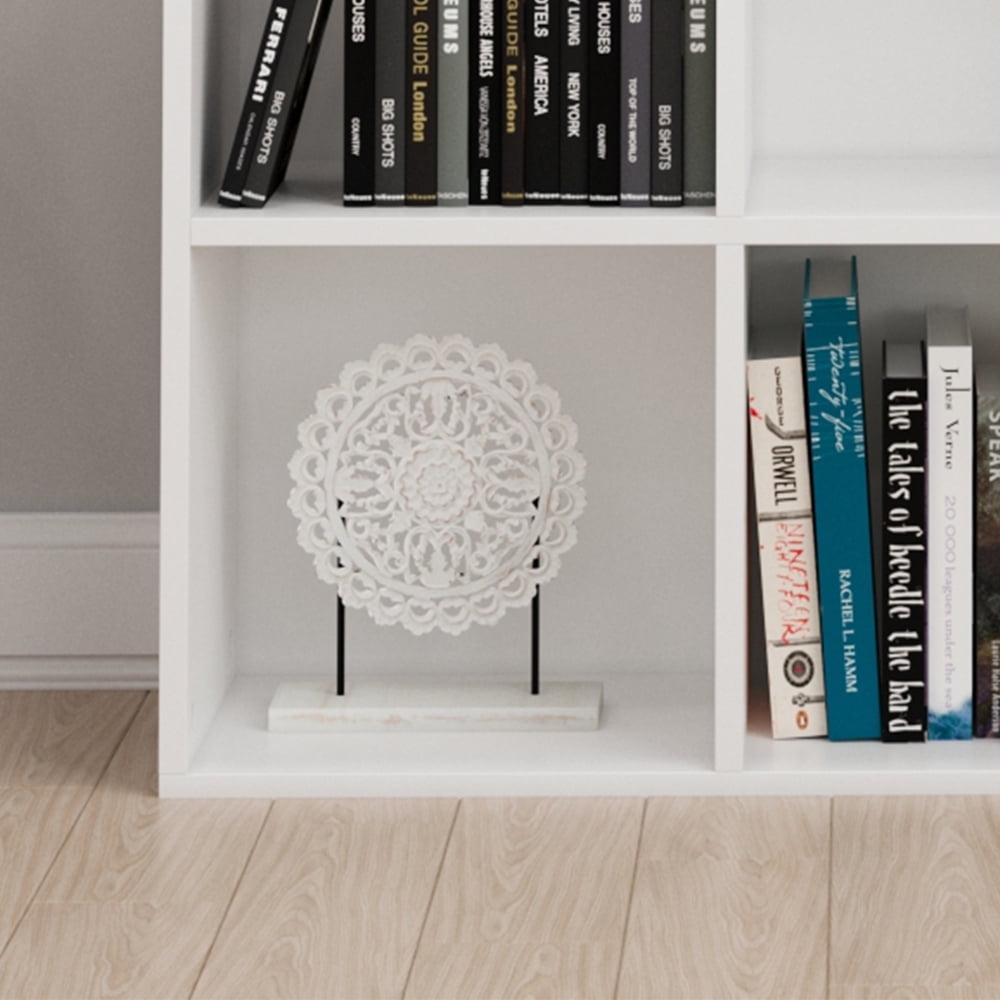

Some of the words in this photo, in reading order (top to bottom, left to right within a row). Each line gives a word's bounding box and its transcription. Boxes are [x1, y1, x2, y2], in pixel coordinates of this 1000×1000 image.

[412, 20, 429, 75] GUIDE
[568, 6, 580, 47] LIVING
[598, 1, 611, 55] HOUSES
[252, 6, 288, 102] FERRARI
[479, 39, 494, 78] ANGELS
[269, 90, 286, 116] BIG
[505, 65, 518, 133] London
[533, 54, 549, 117] AMERICA
[568, 72, 580, 104] NEW
[628, 77, 637, 96] TOP
[628, 96, 637, 110] OF
[381, 98, 395, 121] BIG
[412, 80, 428, 142] London
[568, 105, 580, 138] YORK
[628, 111, 637, 129] THE
[658, 104, 671, 126] BIG
[257, 115, 279, 165] SHOTS
[351, 117, 360, 157] COUNTRY
[381, 122, 396, 168] SHOTS
[628, 129, 637, 163] WORLD
[658, 127, 672, 171] SHOTS
[940, 365, 971, 411] Jules
[887, 389, 922, 432] the
[944, 418, 961, 471] Verne
[771, 445, 798, 507] ORWELL
[887, 438, 924, 501] tales
[888, 507, 923, 538] of
[943, 494, 957, 521] 20
[838, 568, 855, 627] RACHEL
[887, 544, 925, 619] beedle
[942, 566, 956, 616] leagues
[841, 627, 855, 643] L.
[887, 624, 924, 673] the
[943, 617, 957, 661] under
[842, 643, 858, 694] HAMM
[944, 662, 958, 685] the
[887, 679, 925, 734] bard
[945, 687, 955, 711] sea
